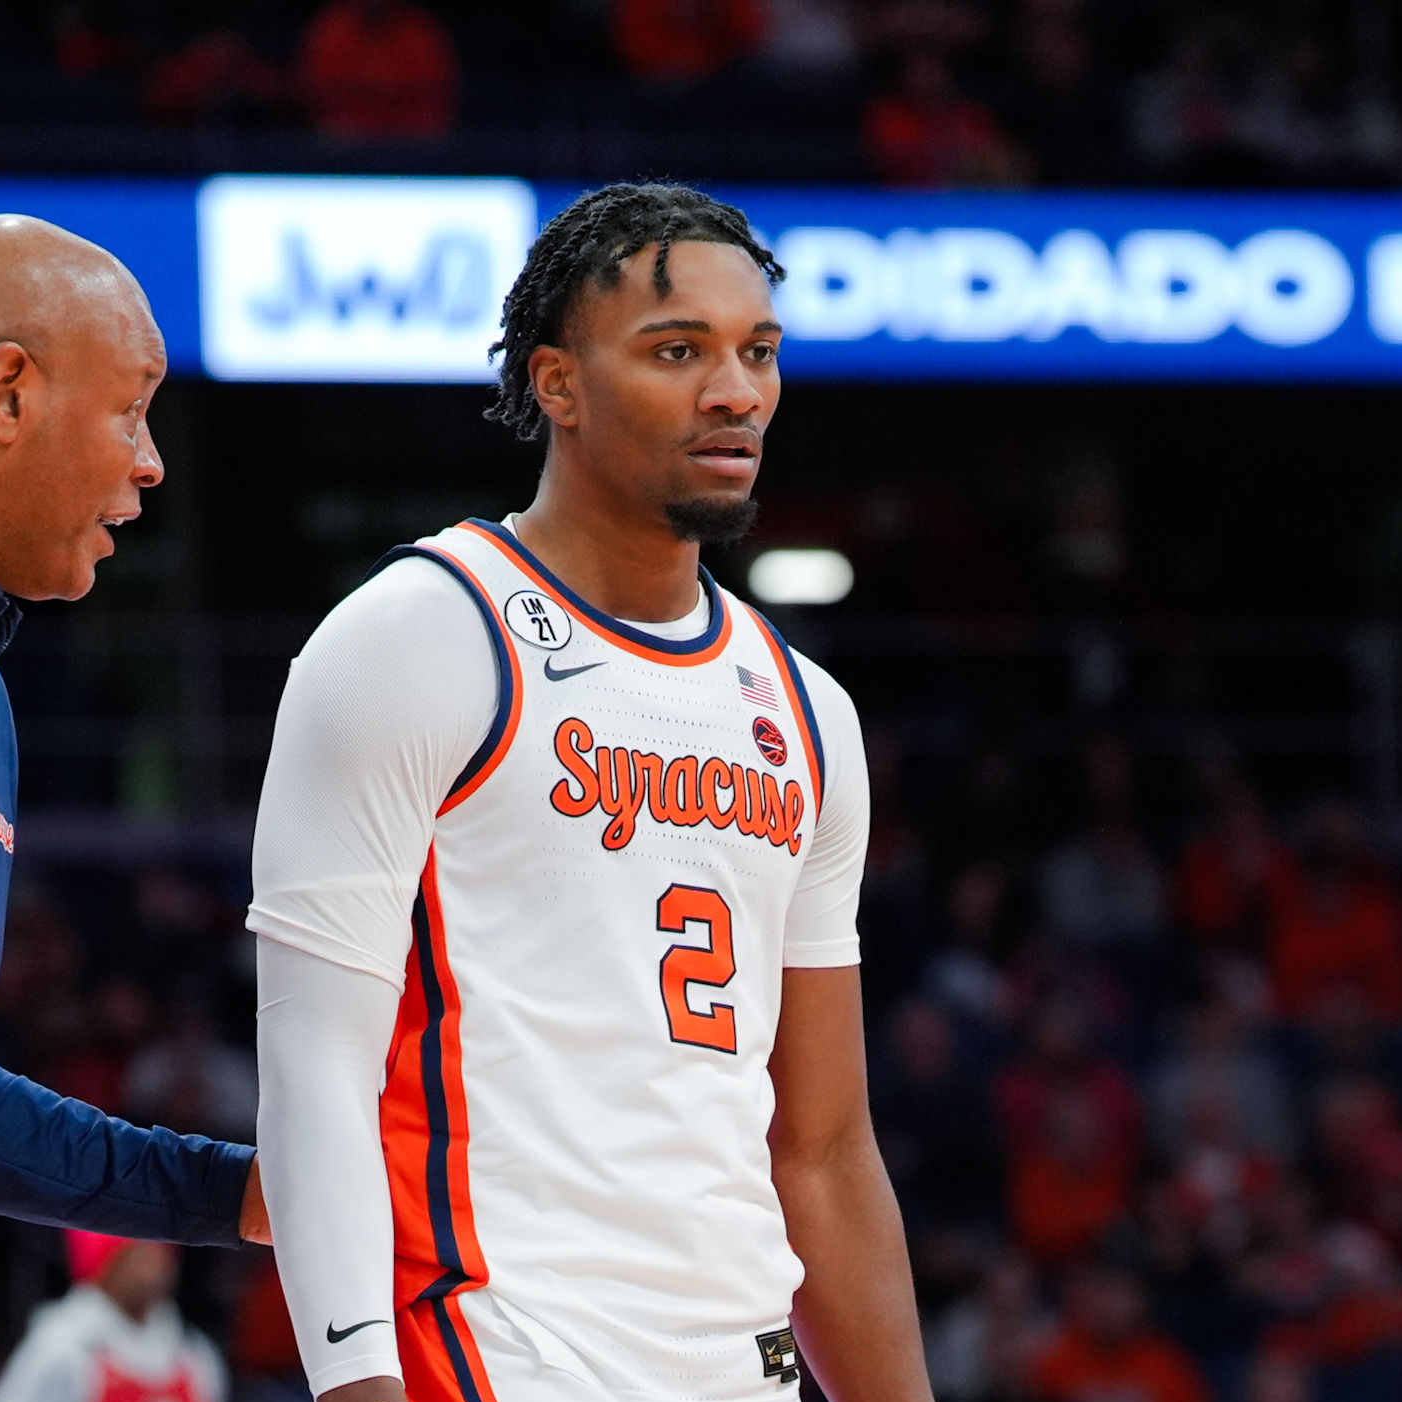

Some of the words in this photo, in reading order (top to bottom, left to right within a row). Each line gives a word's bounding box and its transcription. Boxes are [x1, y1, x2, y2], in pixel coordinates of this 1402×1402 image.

[521, 598, 546, 615] LM
[531, 617, 557, 641] 21
[550, 717, 805, 857] Syracuse
[656, 882, 737, 1055] 2
